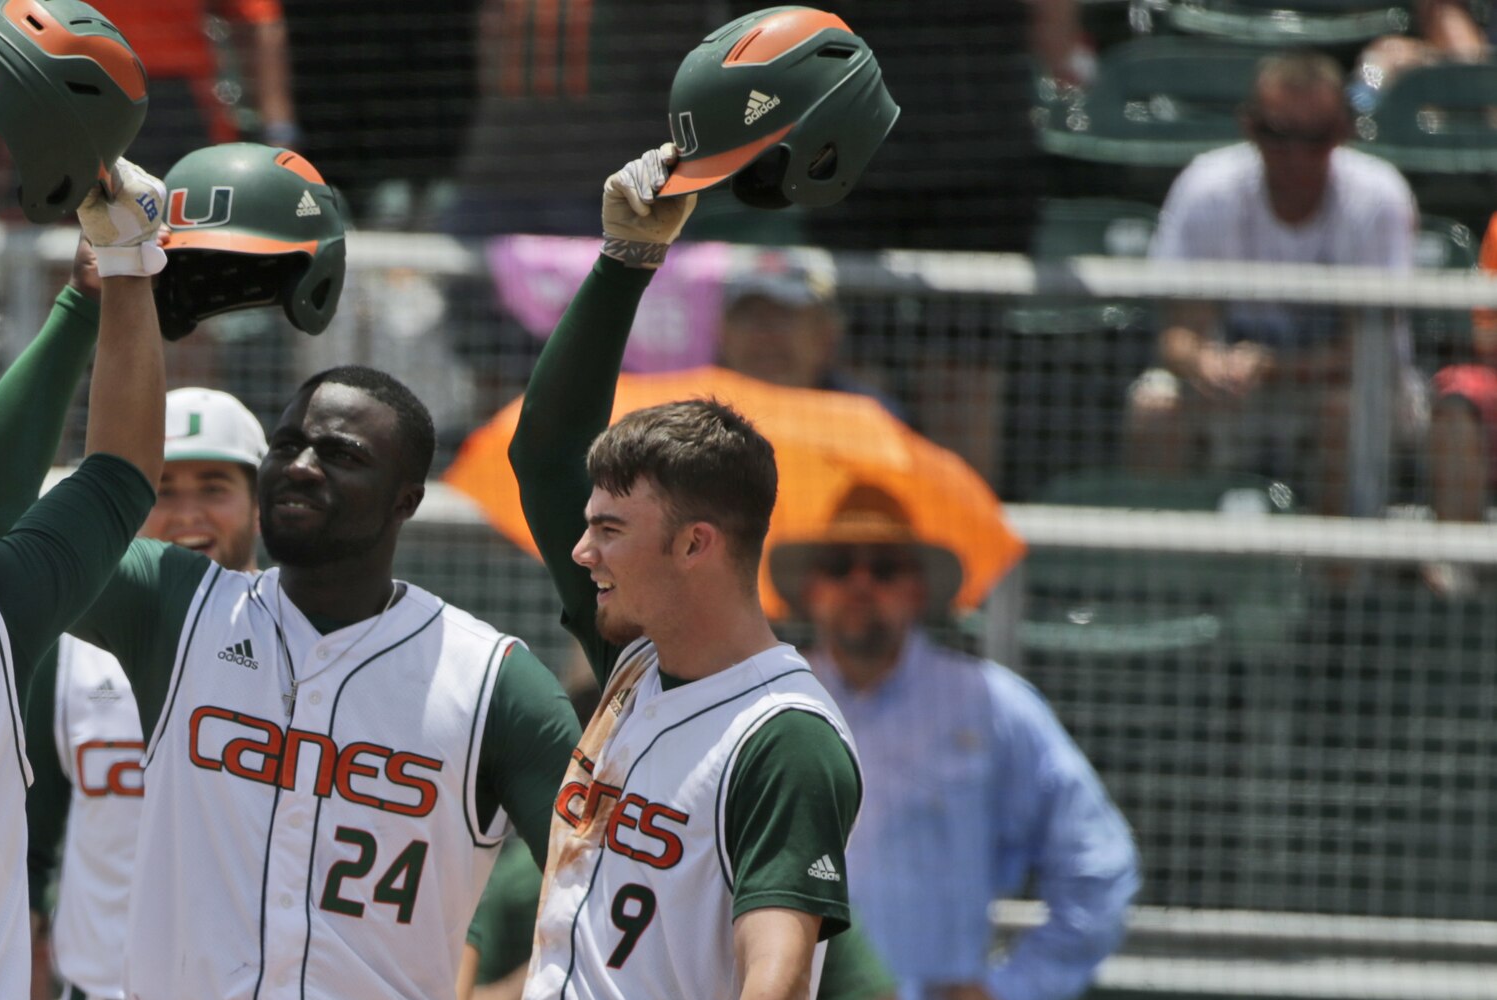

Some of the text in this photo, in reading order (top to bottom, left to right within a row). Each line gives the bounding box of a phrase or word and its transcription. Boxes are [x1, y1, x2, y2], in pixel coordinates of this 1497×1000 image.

[744, 95, 781, 125] adidas
[166, 186, 234, 229] U
[217, 650, 259, 670] adidas
[319, 825, 429, 925] 24
[606, 882, 657, 970] 9
